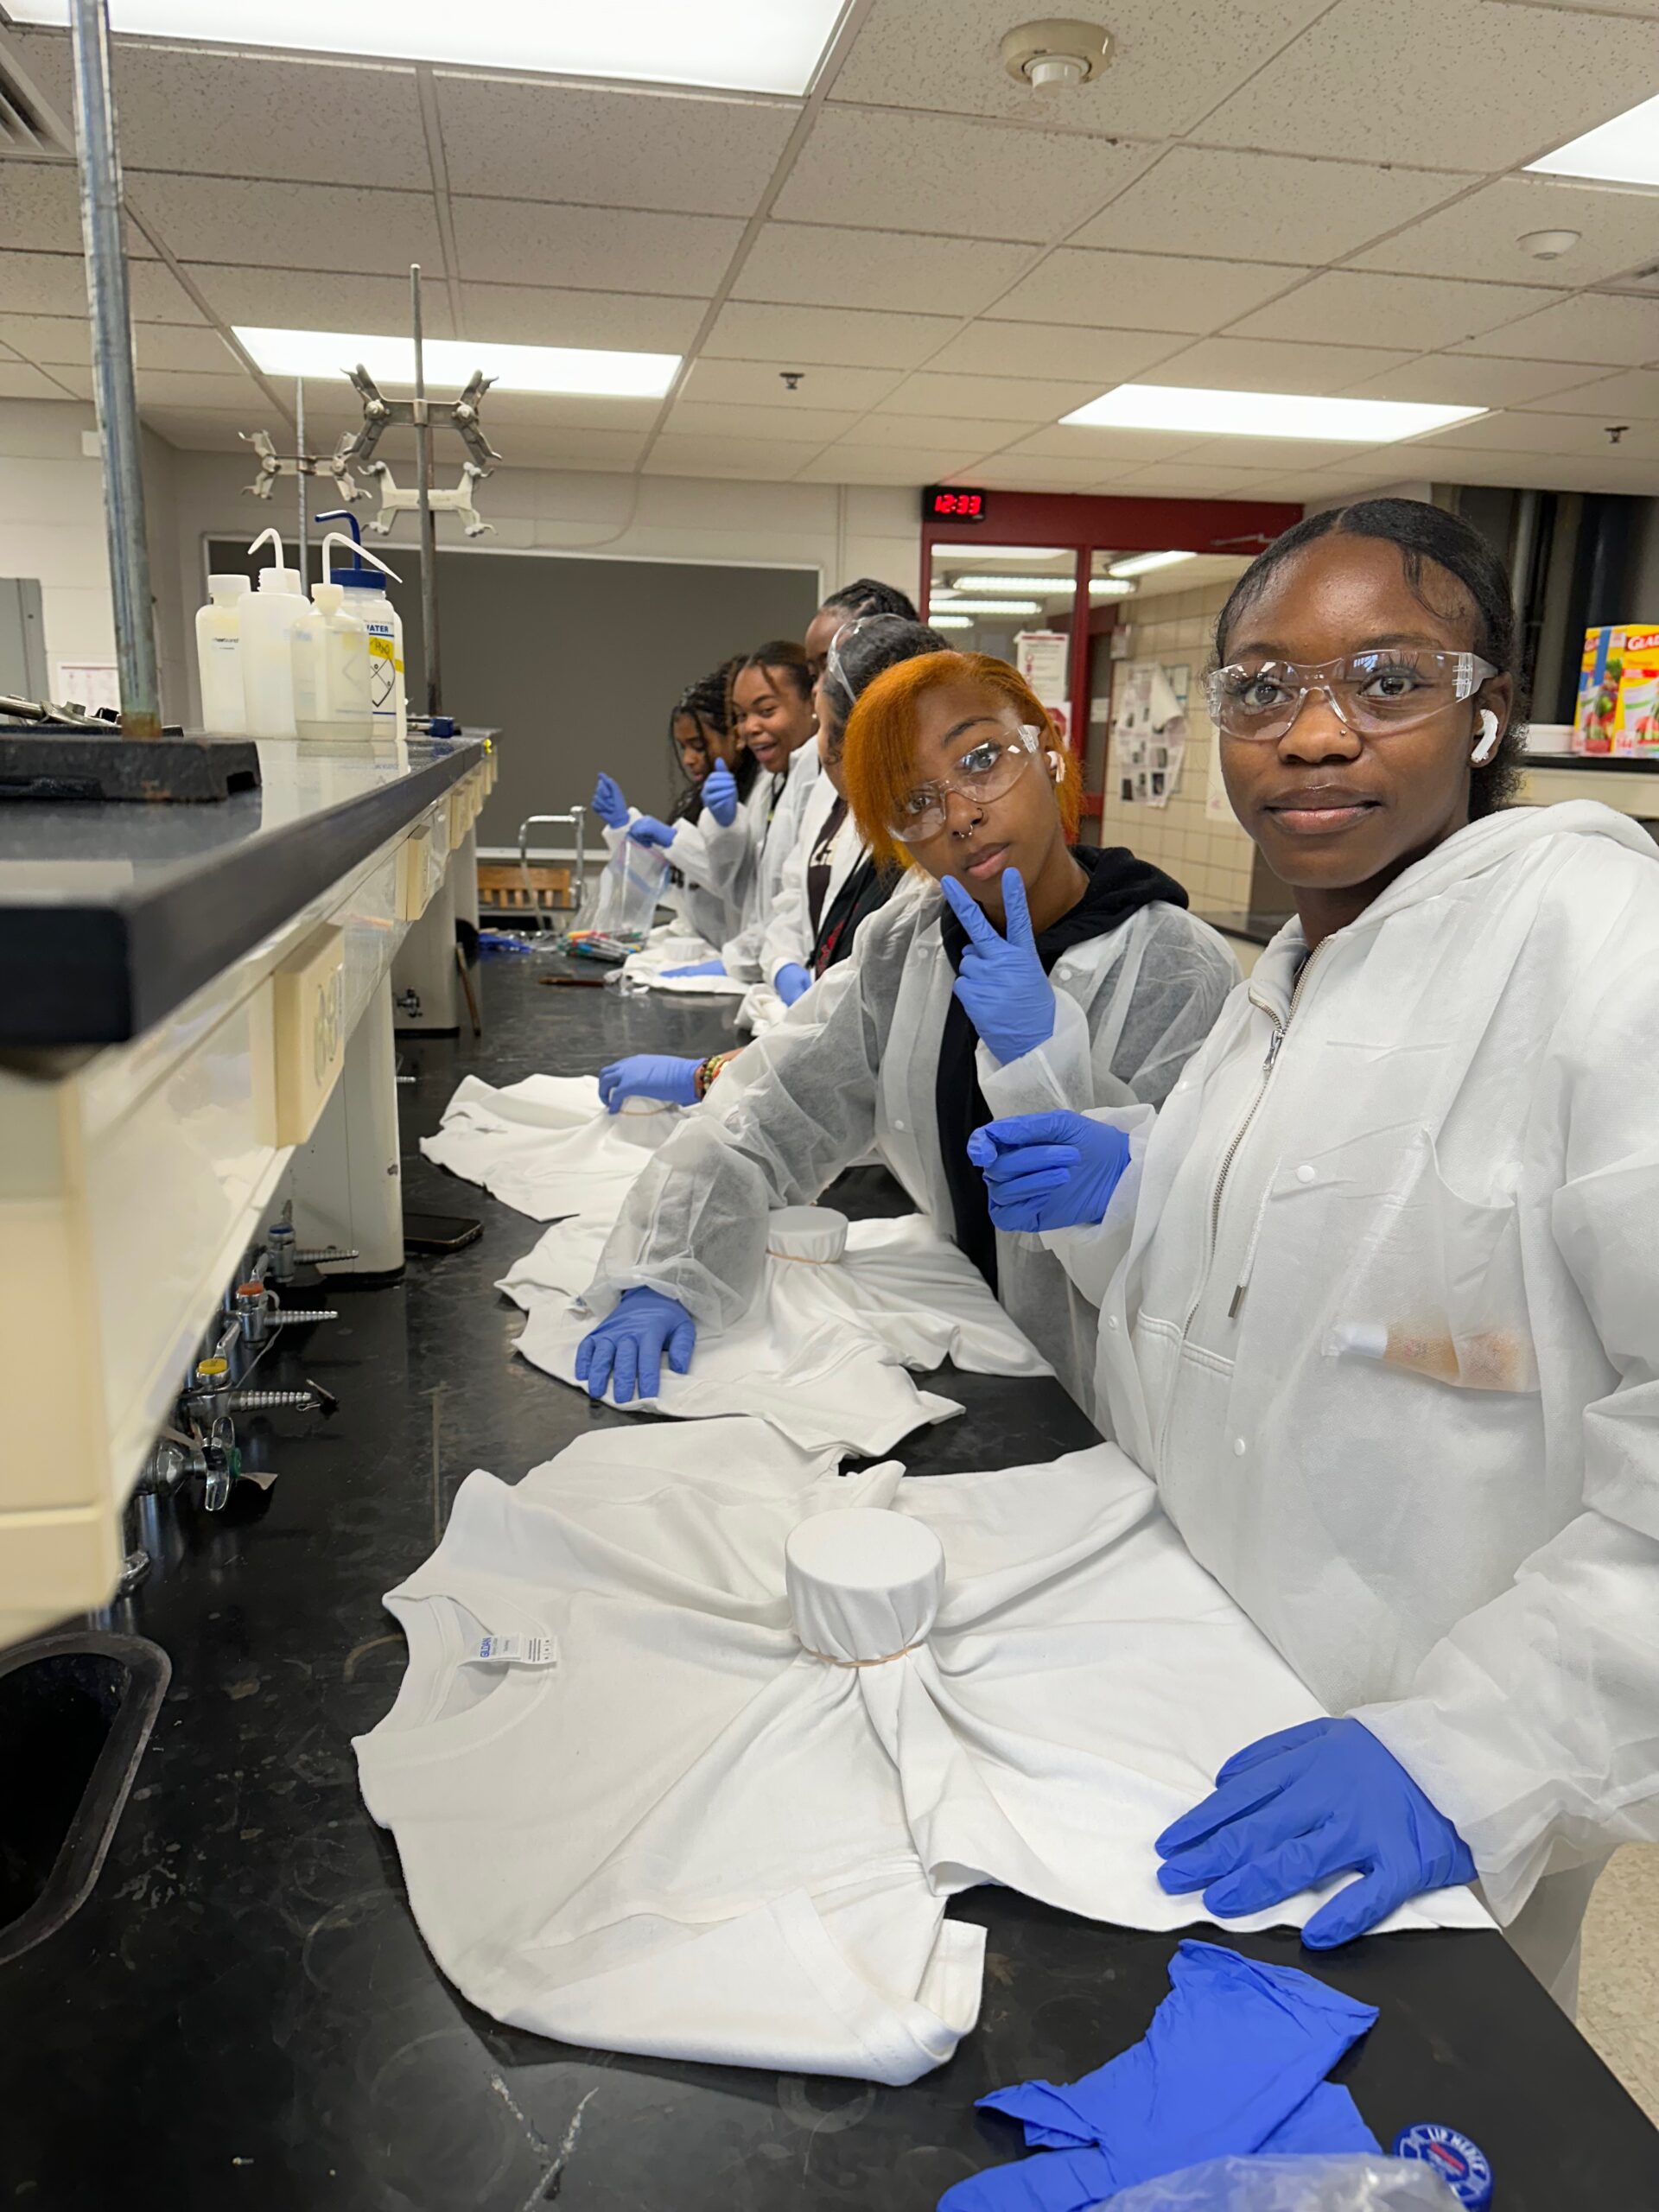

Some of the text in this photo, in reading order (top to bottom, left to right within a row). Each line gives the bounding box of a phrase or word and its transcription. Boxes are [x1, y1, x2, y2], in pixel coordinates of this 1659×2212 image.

[934, 493, 982, 515] 12:33
[366, 624, 389, 632] ATER
[480, 1637, 492, 1658] GILDAN
